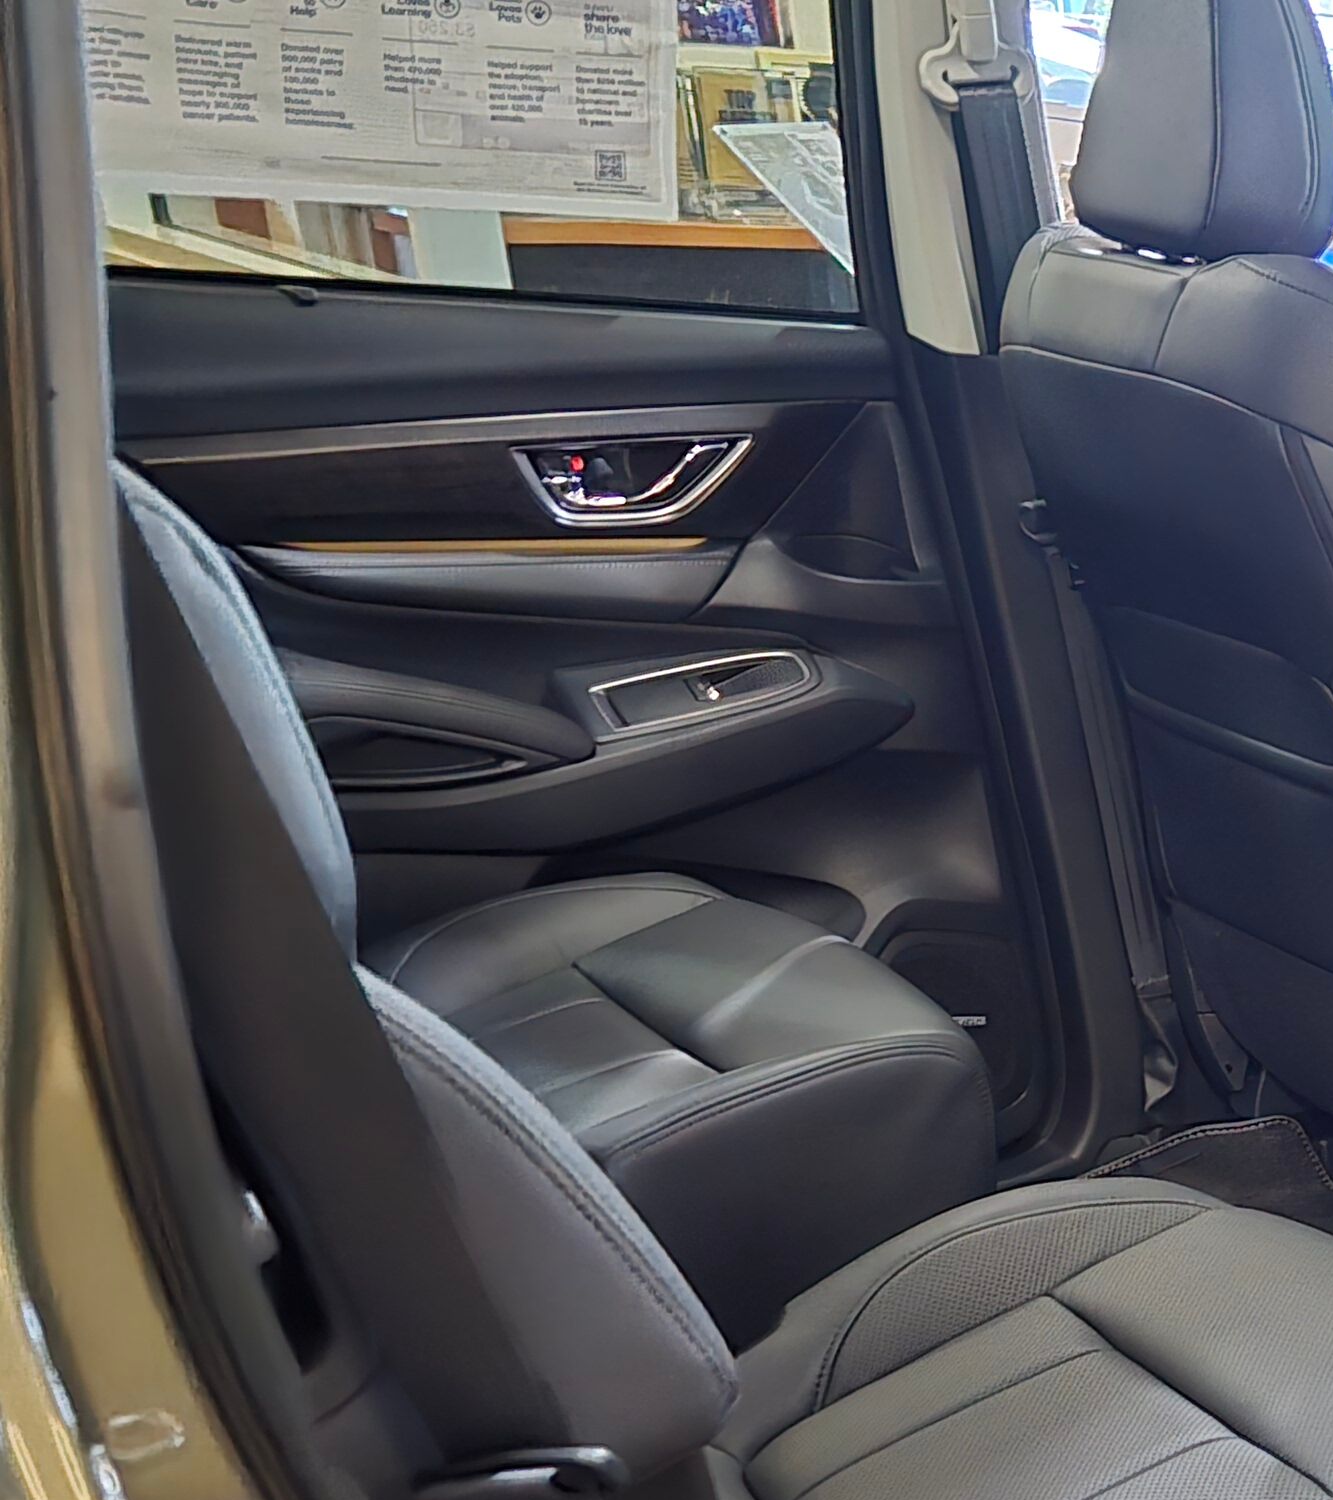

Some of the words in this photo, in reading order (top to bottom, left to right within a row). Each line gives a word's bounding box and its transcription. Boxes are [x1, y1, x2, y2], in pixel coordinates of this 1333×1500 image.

[290, 5, 317, 17] Help
[381, 4, 432, 19] Learning
[489, 2, 522, 13] Loves
[498, 13, 523, 24] Pets
[584, 11, 619, 23] share
[584, 22, 605, 34] the
[607, 24, 632, 36] love
